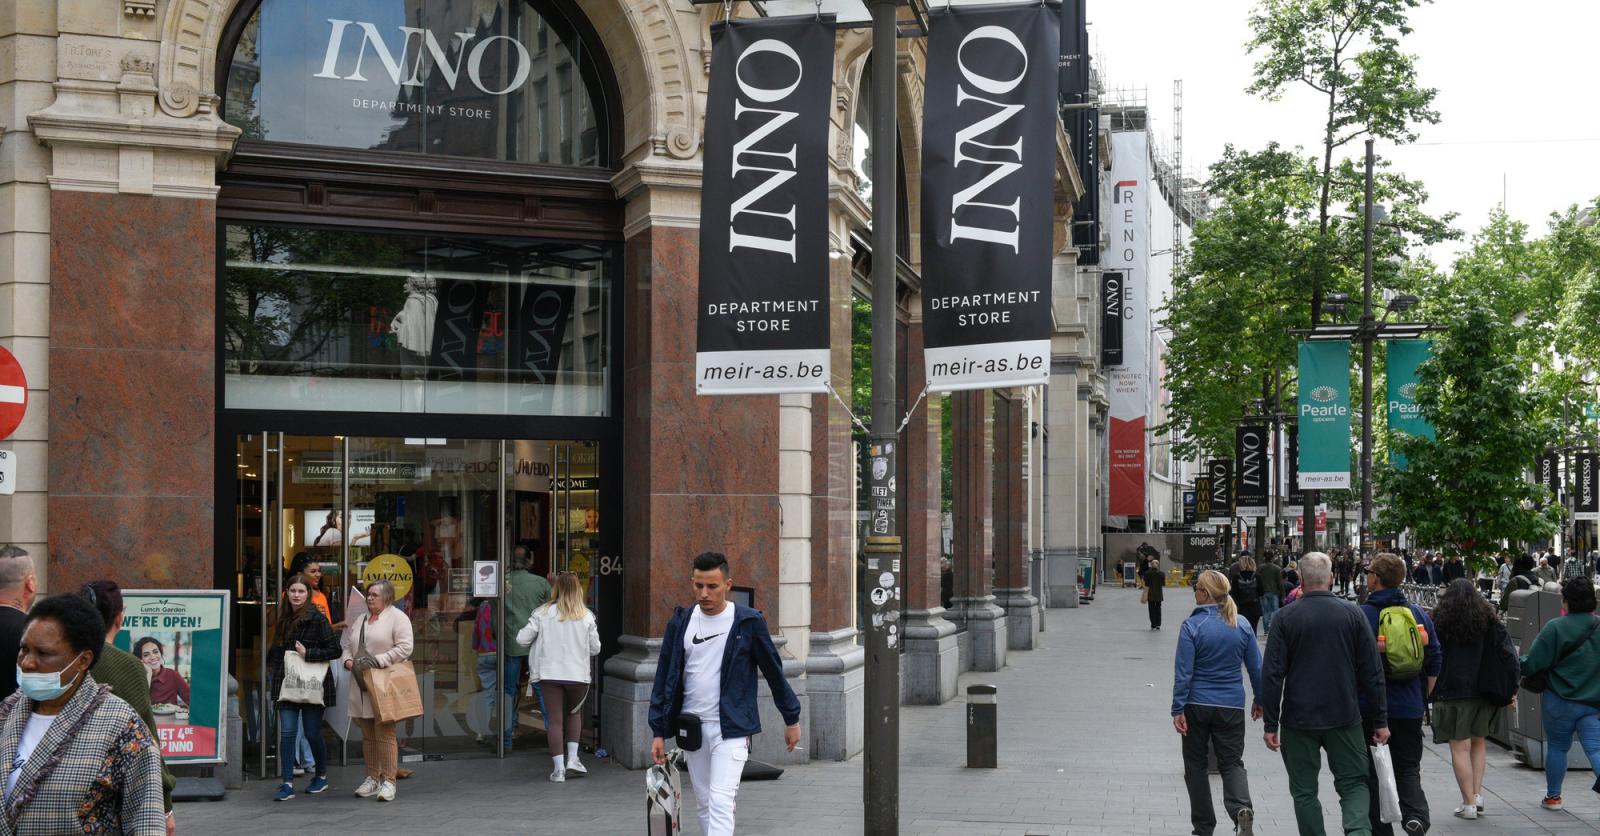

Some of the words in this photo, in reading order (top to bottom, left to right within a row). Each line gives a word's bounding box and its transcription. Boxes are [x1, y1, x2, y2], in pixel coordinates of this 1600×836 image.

[313, 18, 531, 95] INNO
[353, 98, 444, 115] DEPARTMENT
[450, 107, 492, 119] STORE
[949, 25, 1028, 255] INNO
[729, 38, 802, 263] INNO
[708, 300, 819, 315] DEPARTMENT
[931, 290, 1040, 310] DEPARTMENT
[1107, 279, 1119, 316] INNO
[736, 319, 790, 332] STORE
[958, 311, 1010, 326] STORE
[704, 361, 824, 381] meir-as.be
[932, 353, 1043, 377] meir-as.be
[1301, 403, 1346, 416] Pearle
[1389, 401, 1425, 413] Pear
[307, 465, 354, 474] HARTELK
[358, 466, 396, 475] WELKOM
[1242, 432, 1261, 488] INNO
[1213, 464, 1226, 504] INNO
[1582, 458, 1592, 506] NESPRESSO
[1190, 537, 1216, 547] snipes
[600, 555, 623, 575] 84
[365, 573, 412, 581] AMAZING
[121, 616, 158, 628] WE'RE
[163, 616, 202, 628] OPEN!
[168, 741, 193, 753] INNO
